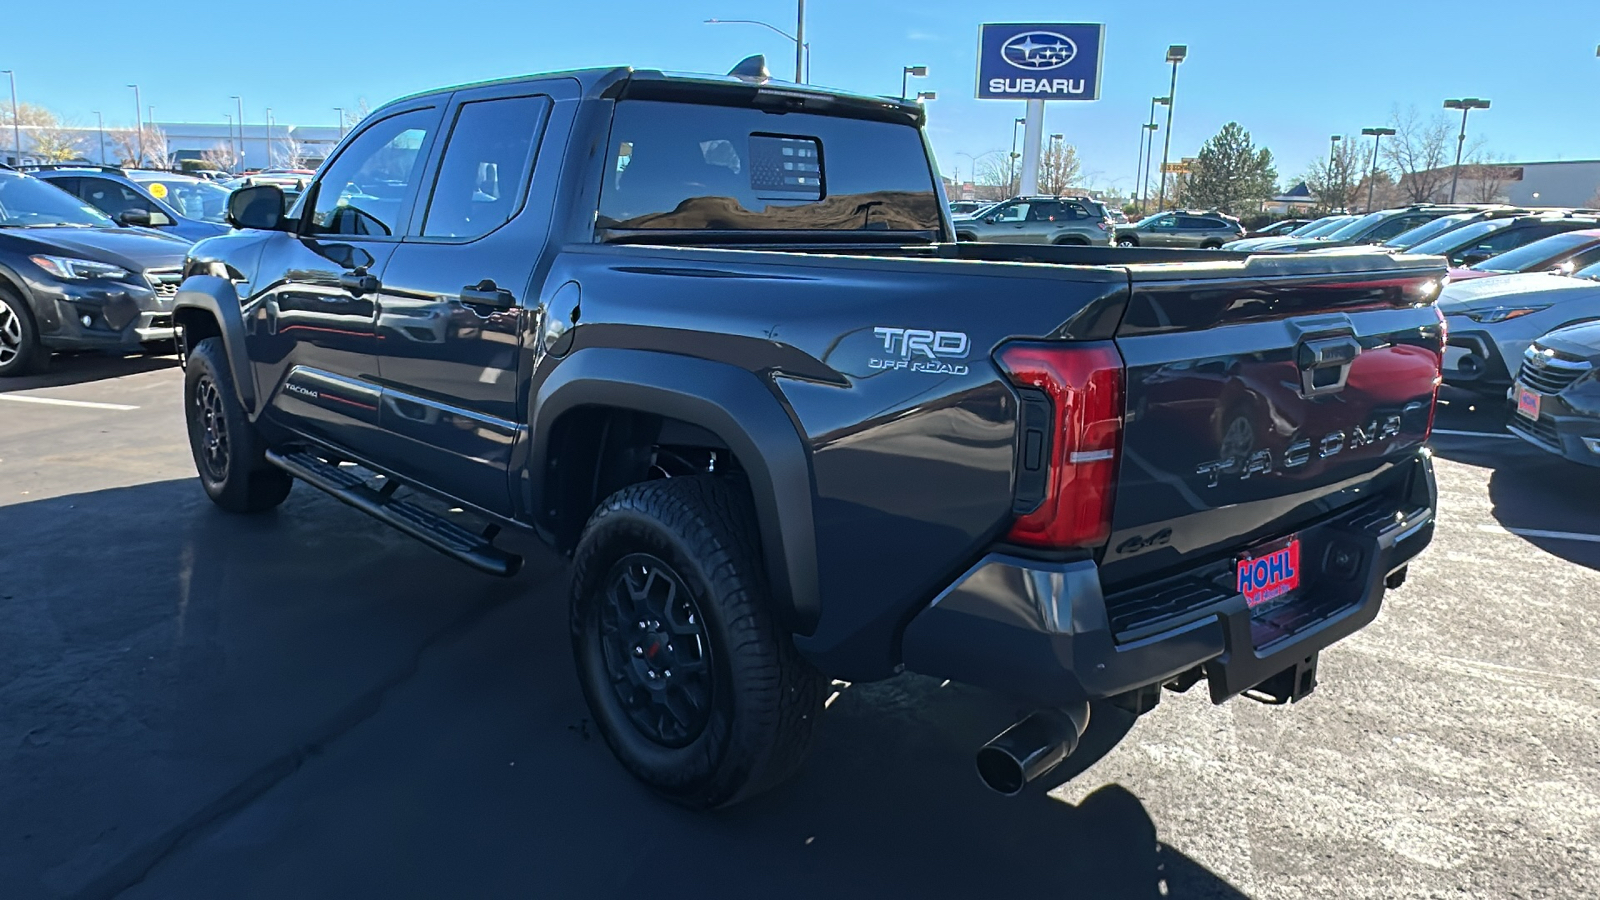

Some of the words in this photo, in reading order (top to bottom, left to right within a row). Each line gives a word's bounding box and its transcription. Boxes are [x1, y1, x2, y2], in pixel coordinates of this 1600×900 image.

[989, 78, 1085, 94] SUBARU
[873, 326, 971, 361] TRD
[868, 358, 908, 371] OFF
[911, 361, 969, 376] ROAD
[285, 382, 318, 398] TACOMA
[1196, 415, 1401, 488] TACOMA
[1239, 551, 1294, 593] HOHL
